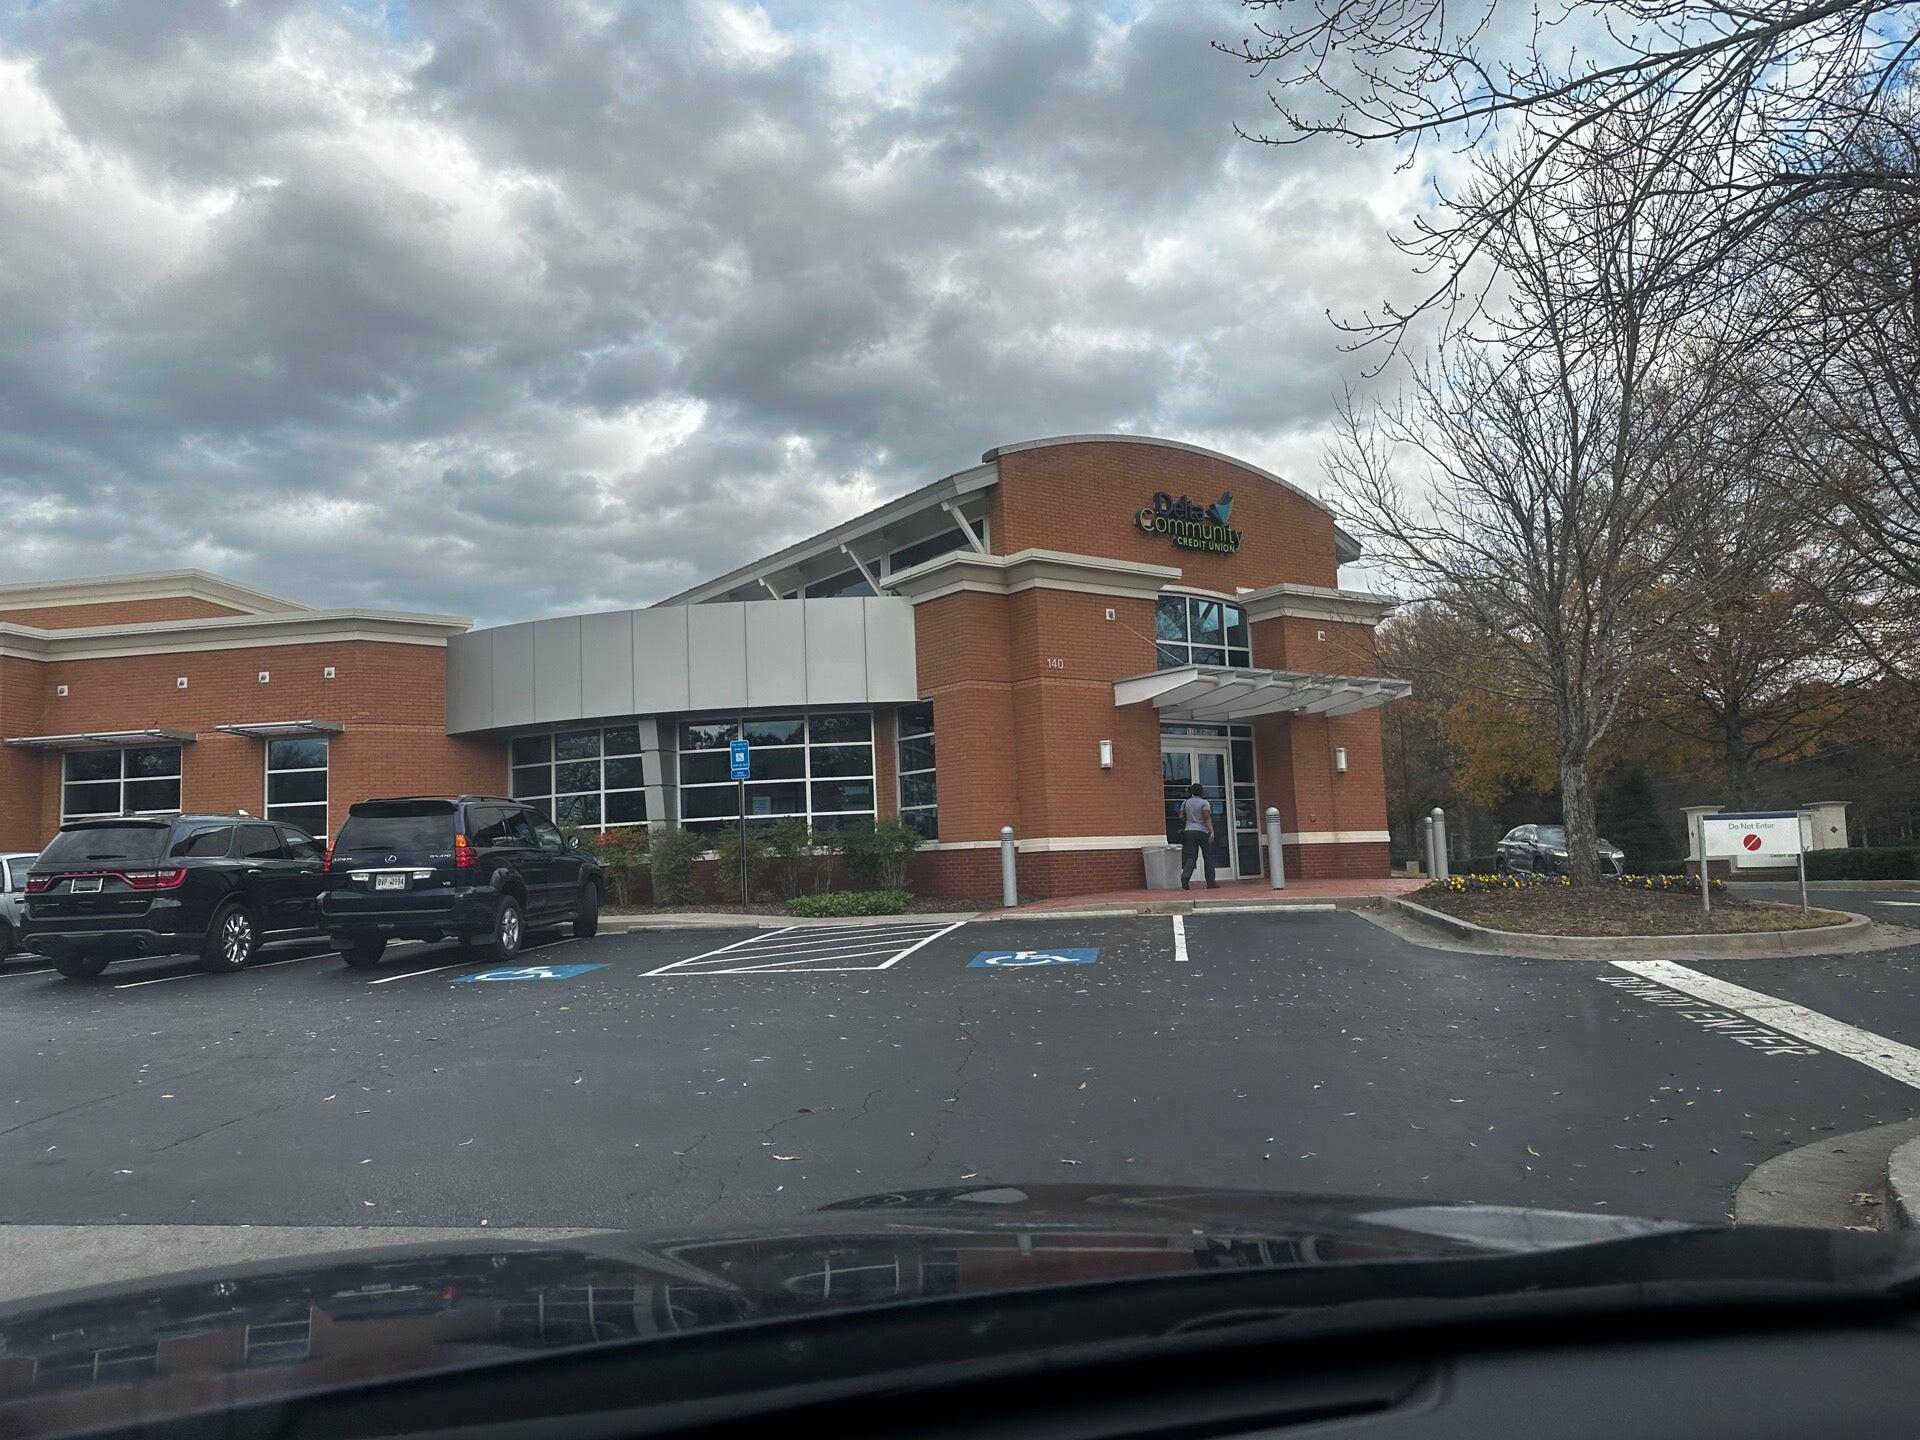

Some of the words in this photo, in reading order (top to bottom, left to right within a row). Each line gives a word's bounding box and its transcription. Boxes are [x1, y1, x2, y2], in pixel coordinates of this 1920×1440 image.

[1155, 492, 1205, 521] Delta
[1137, 507, 1243, 551] Community
[1177, 536, 1206, 550] CREDIT
[1208, 541, 1236, 553] UNION
[1047, 658, 1064, 670] 140
[1728, 822, 1739, 830] Do
[1740, 822, 1754, 830] Not
[1755, 822, 1776, 830] Enter
[1676, 1010, 1821, 1056] ENTER
